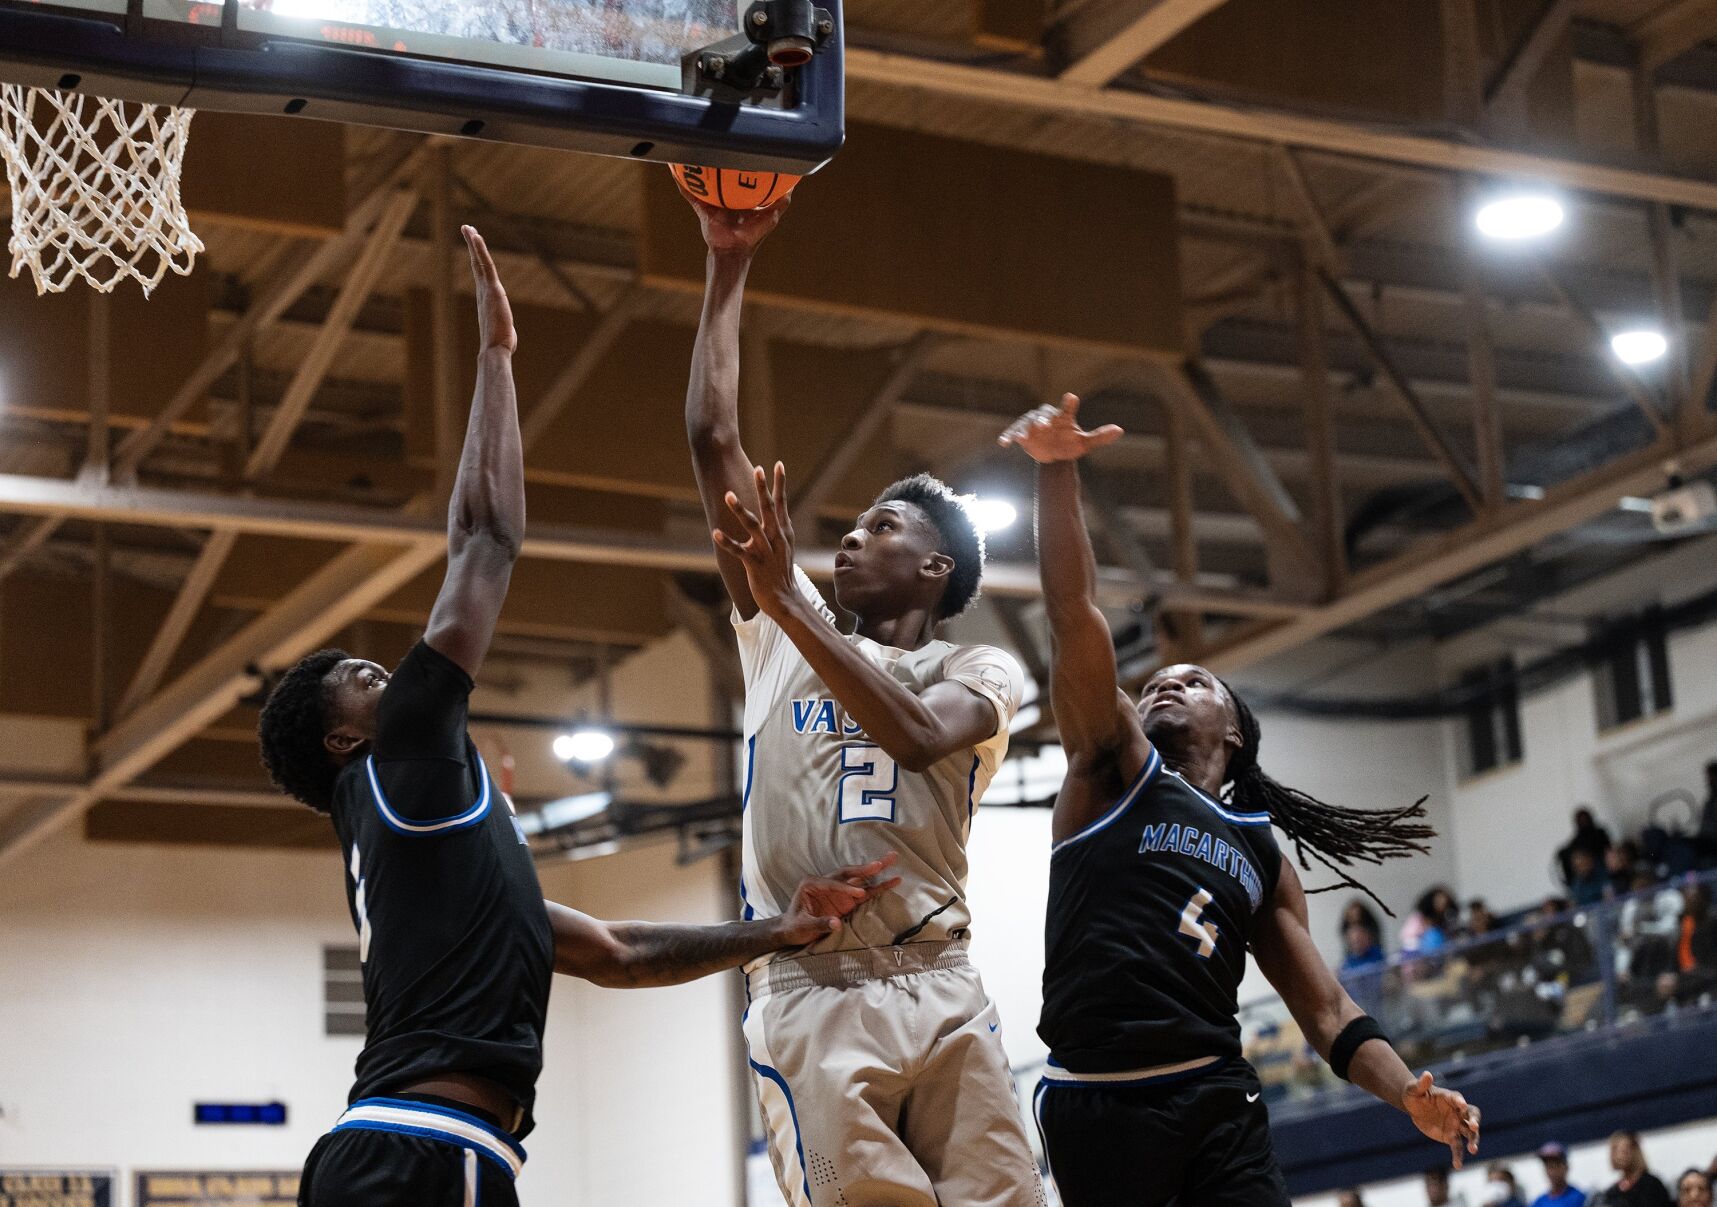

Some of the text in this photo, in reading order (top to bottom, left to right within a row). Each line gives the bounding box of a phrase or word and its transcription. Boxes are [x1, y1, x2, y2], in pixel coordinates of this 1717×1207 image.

[838, 745, 899, 824] 2
[1138, 822, 1264, 915] MACARTH
[1177, 886, 1219, 958] 4
